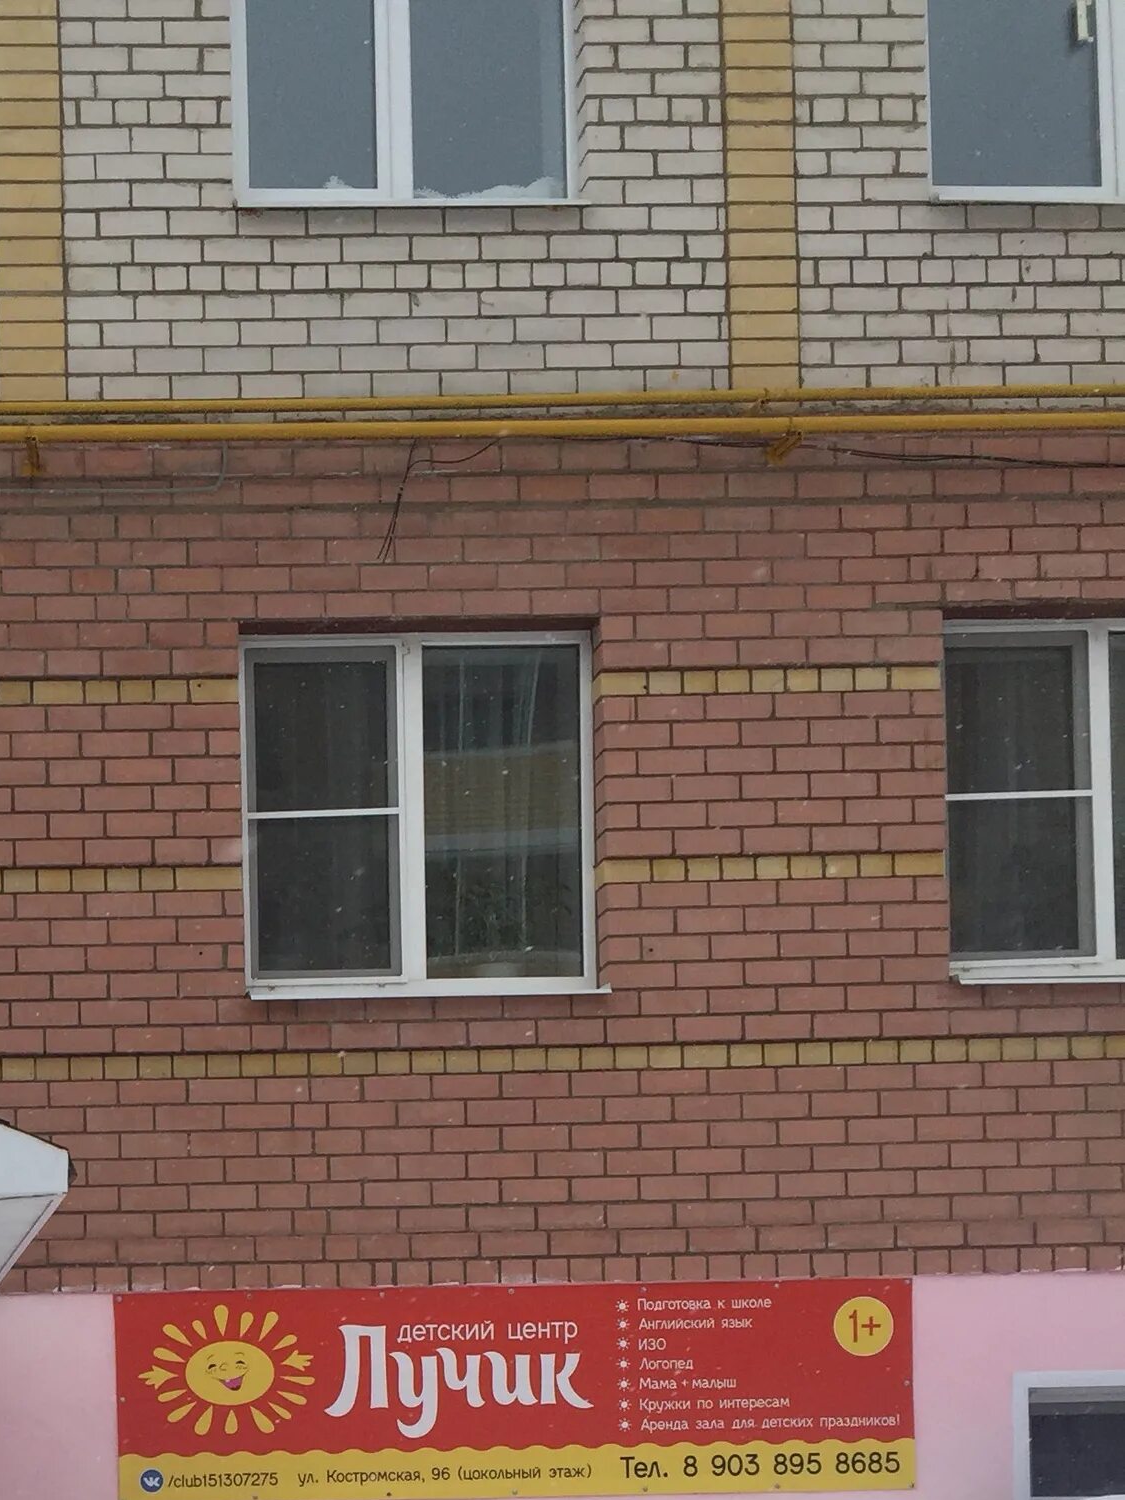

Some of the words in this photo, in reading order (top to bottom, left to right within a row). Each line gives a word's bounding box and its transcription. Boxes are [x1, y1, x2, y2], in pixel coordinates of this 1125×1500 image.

[637, 1298, 711, 1313] Подготовка
[717, 1300, 726, 1310] к
[731, 1297, 772, 1309] школе
[638, 1316, 716, 1330] Английский
[721, 1317, 753, 1329] язык
[848, 1308, 882, 1343] 1+
[396, 1320, 495, 1344] детский
[507, 1320, 578, 1345] центр
[638, 1337, 667, 1351] ИЗО
[639, 1357, 694, 1371] Логопед
[324, 1324, 594, 1439] Лучик
[639, 1376, 678, 1390] Мама
[691, 1376, 737, 1389] малыш
[639, 1398, 691, 1413] Кружки
[697, 1399, 714, 1410] по
[719, 1396, 791, 1411] интересам
[641, 1416, 689, 1431] Аренда
[695, 1418, 725, 1430] зала
[731, 1418, 755, 1431] для
[761, 1415, 814, 1429] детских
[820, 1413, 902, 1429] праздников!
[620, 1455, 669, 1478] Тел.
[682, 1454, 699, 1478] 8
[711, 1453, 760, 1476] 903
[773, 1452, 822, 1475] 895
[835, 1450, 901, 1474] 8685
[167, 1472, 279, 1488] /club151307275
[297, 1472, 319, 1487] ул.
[326, 1469, 425, 1486] Костромская,
[431, 1466, 451, 1481] 96
[457, 1465, 542, 1482] (цокольный
[549, 1463, 593, 1480] этаж)
